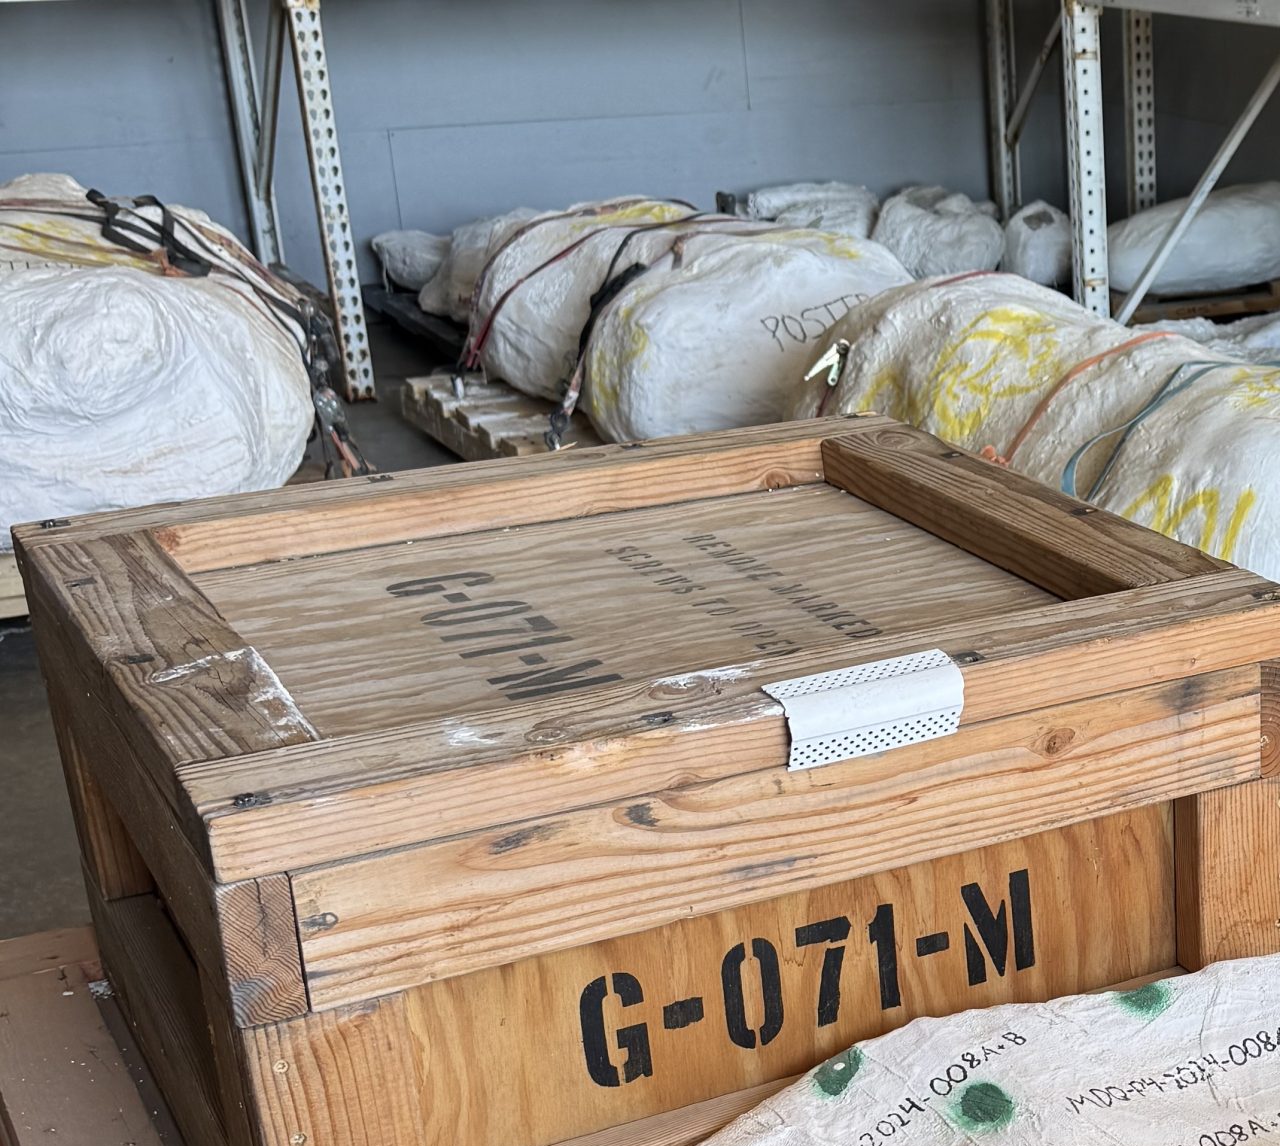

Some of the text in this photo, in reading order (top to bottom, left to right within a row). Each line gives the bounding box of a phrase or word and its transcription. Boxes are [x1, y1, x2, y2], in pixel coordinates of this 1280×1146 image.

[385, 571, 624, 700] G-071-M
[604, 545, 706, 594] SCREWS
[692, 598, 739, 616] TO
[682, 534, 883, 638] REMOVE MARKED
[579, 869, 1036, 1088] G-071-M
